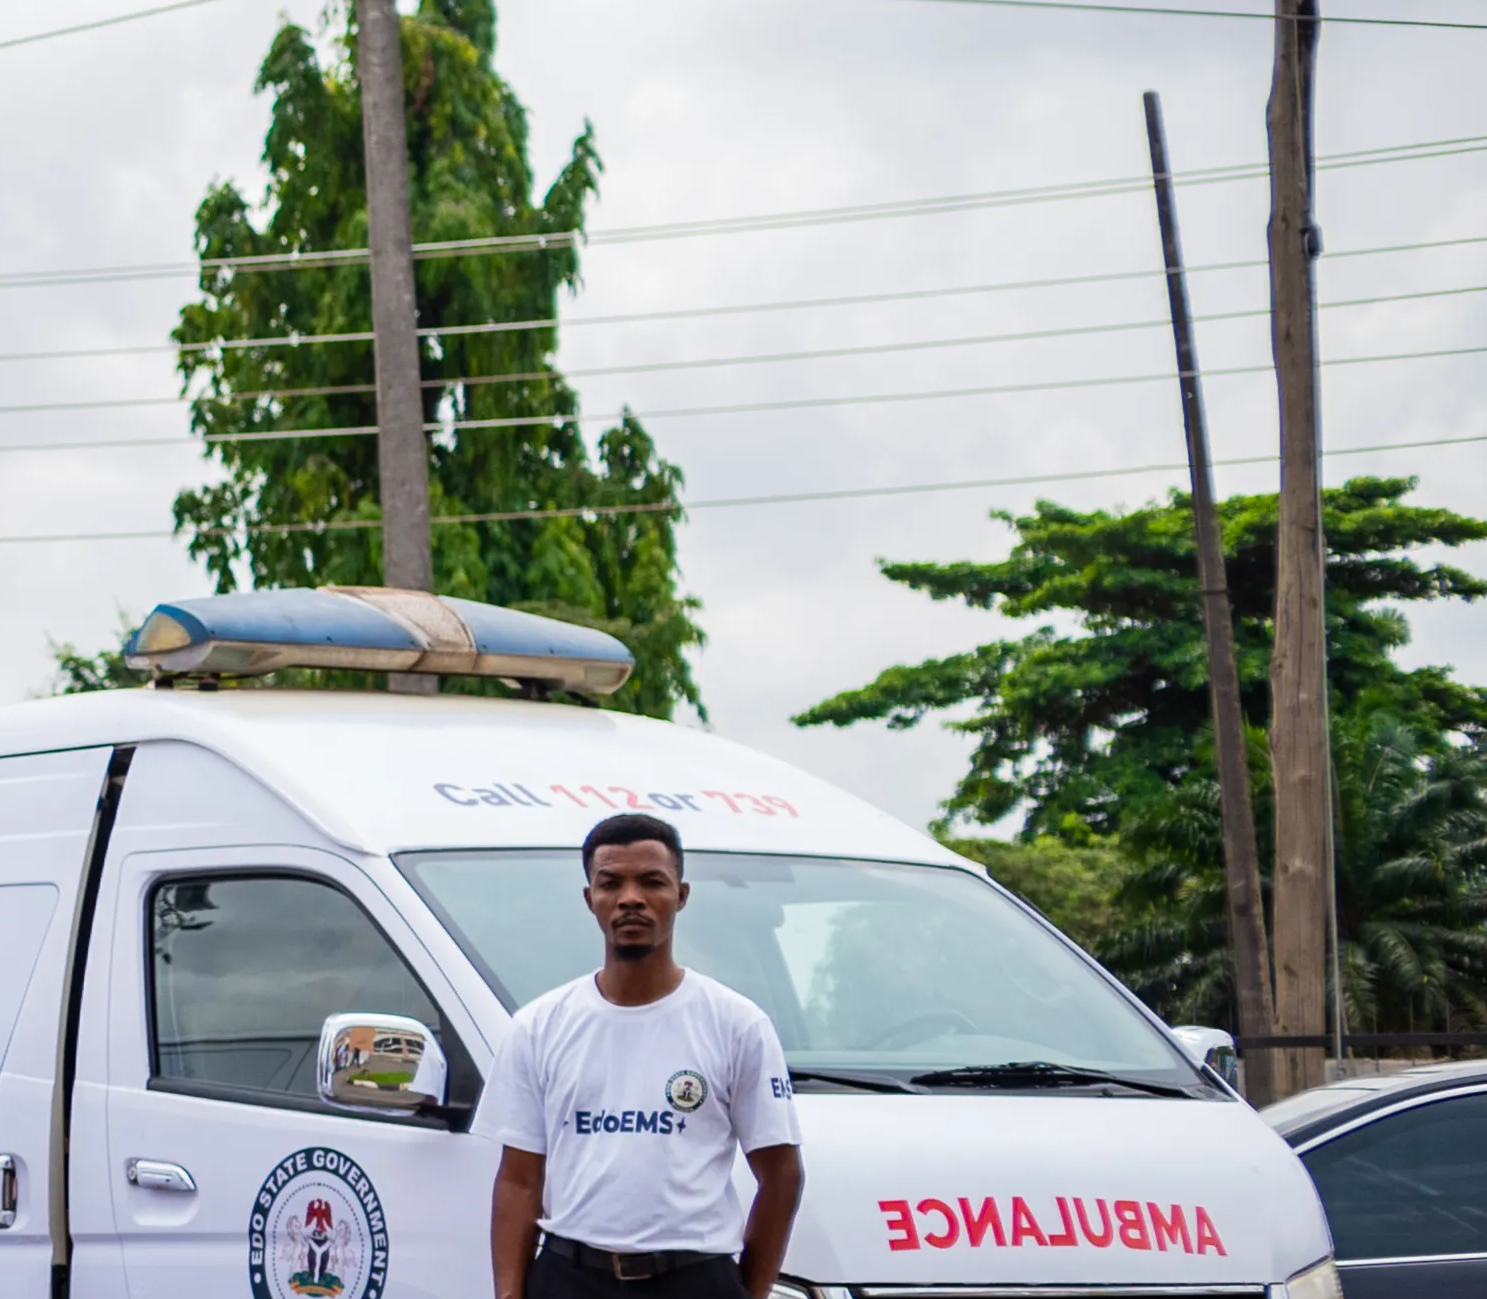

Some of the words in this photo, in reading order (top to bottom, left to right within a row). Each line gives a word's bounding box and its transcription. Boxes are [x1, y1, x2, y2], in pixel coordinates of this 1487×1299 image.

[433, 782, 553, 808] Call
[549, 784, 656, 810] 112
[647, 792, 703, 812] or
[700, 789, 801, 819] 739
[575, 1110, 674, 1135] EdoEMS
[251, 1212, 264, 1266] EDO
[259, 1153, 307, 1209] STATE
[312, 1149, 388, 1287] GOVERNMENT
